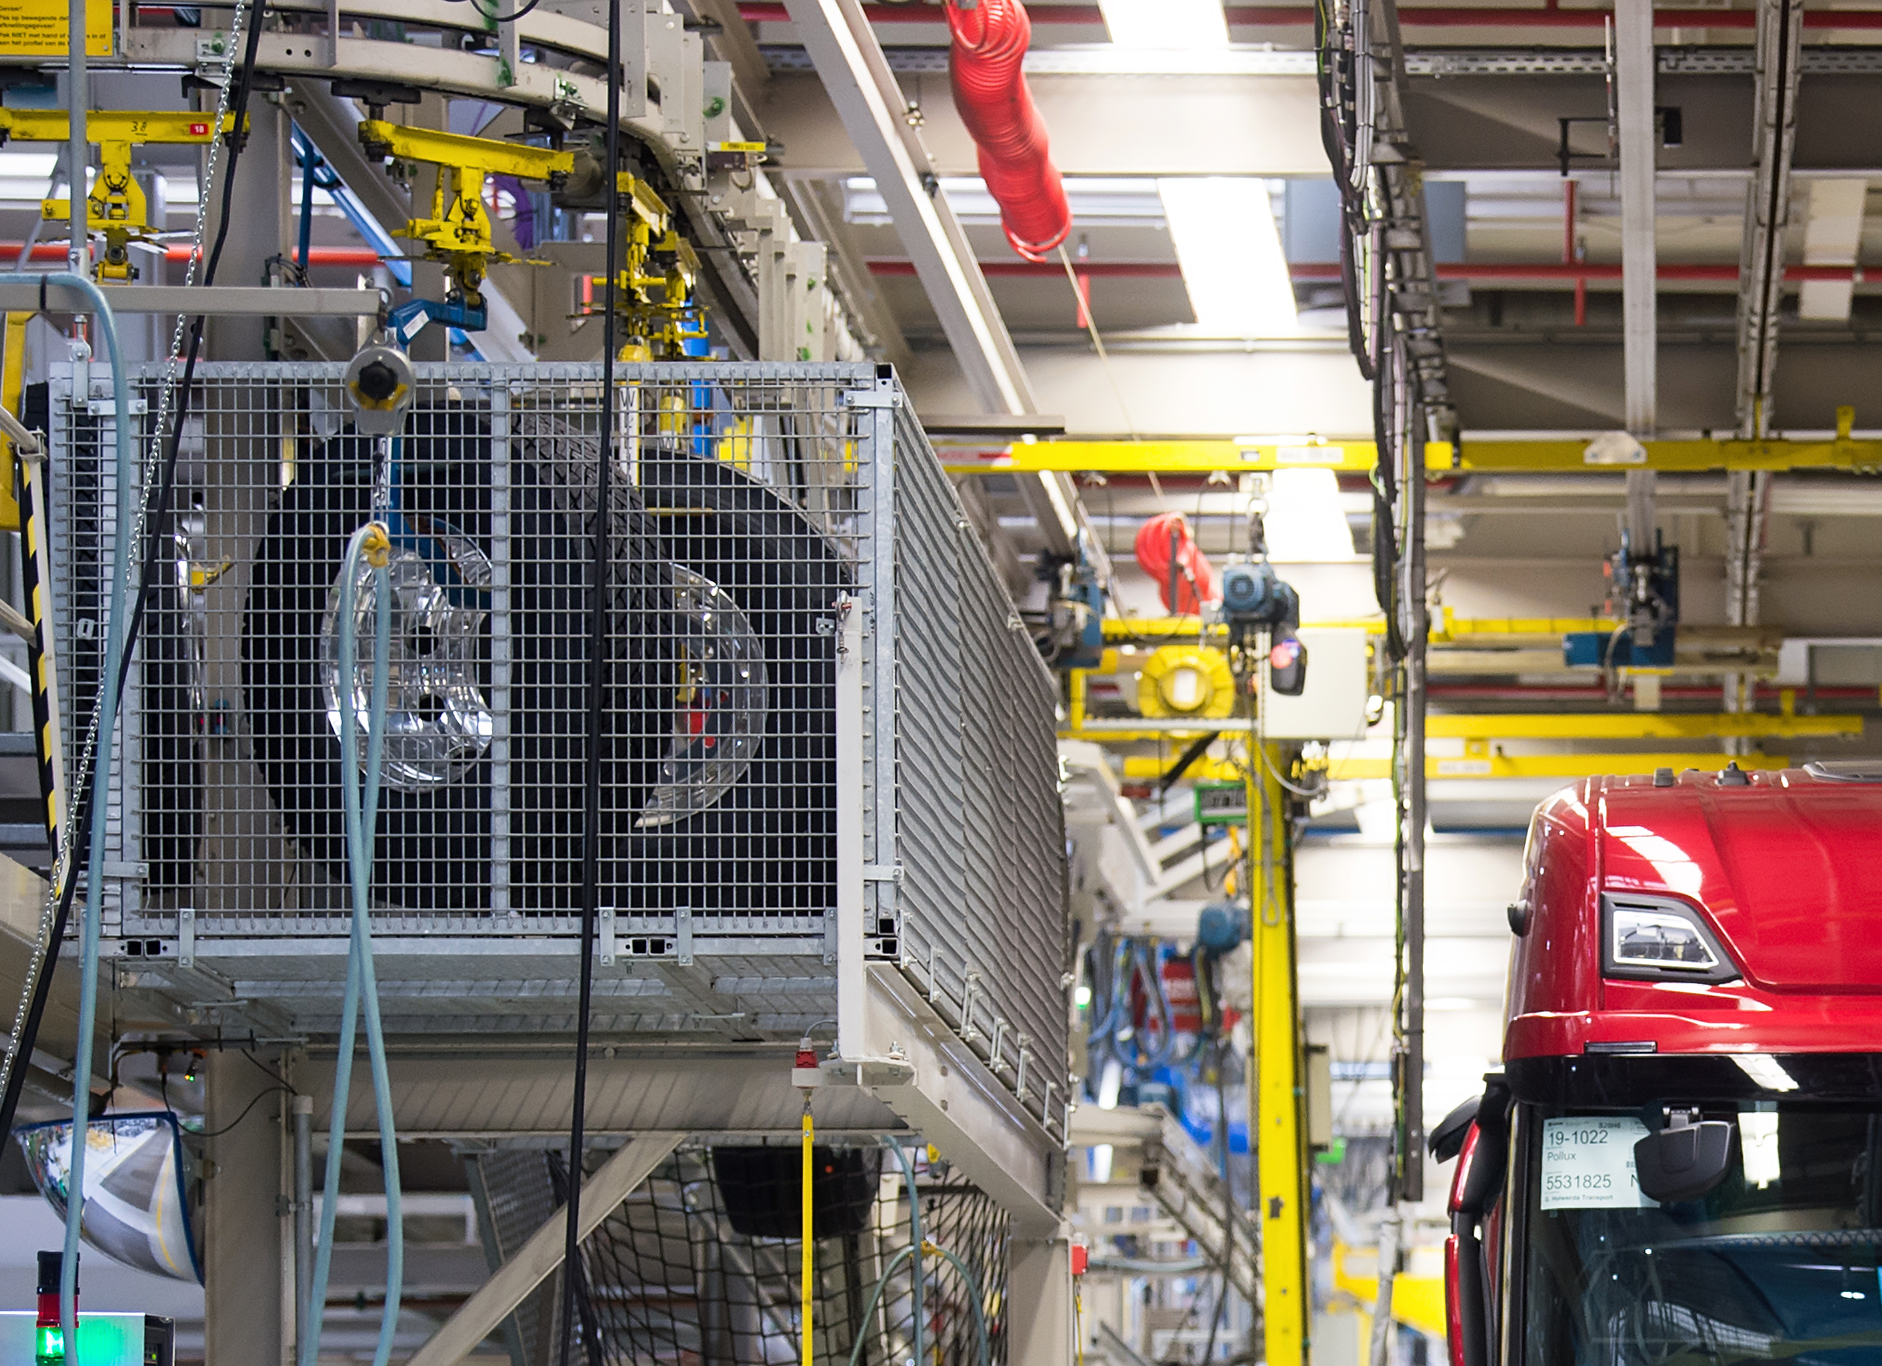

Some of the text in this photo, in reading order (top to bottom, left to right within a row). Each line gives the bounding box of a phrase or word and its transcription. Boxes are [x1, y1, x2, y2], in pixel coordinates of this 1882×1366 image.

[1548, 1129, 1609, 1146] 19-1022
[1548, 1151, 1576, 1161] Pollux
[1546, 1174, 1612, 1190] 5531825
